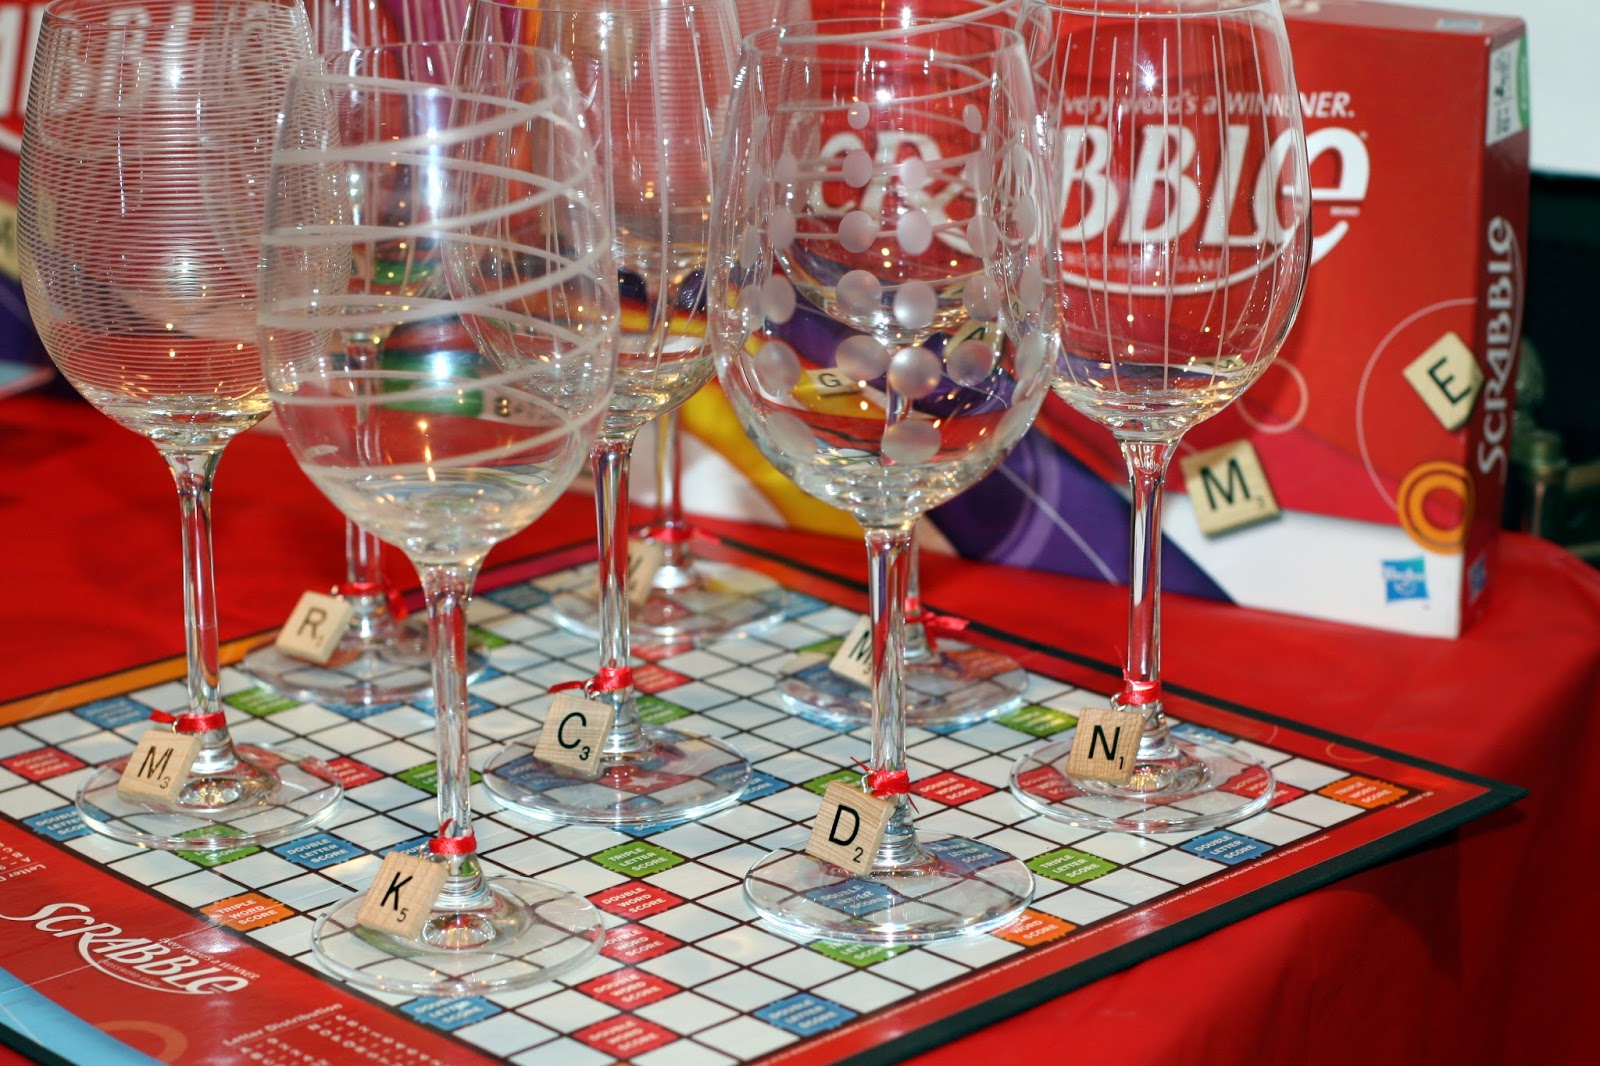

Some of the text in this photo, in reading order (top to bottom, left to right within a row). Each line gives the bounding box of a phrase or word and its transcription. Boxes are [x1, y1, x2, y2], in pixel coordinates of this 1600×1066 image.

[1044, 92, 1107, 121] very
[1429, 356, 1473, 405] E
[1200, 457, 1251, 512] M
[297, 606, 327, 639] R
[557, 711, 587, 749] C
[1087, 724, 1121, 761] N
[137, 745, 175, 781] M
[919, 776, 960, 793] DOUBLE
[934, 783, 966, 796] WORD
[945, 786, 980, 801] SCORE
[828, 803, 861, 847] D
[286, 837, 331, 856] DOUBLE
[1194, 834, 1233, 852] DOUBLE
[1209, 839, 1244, 856] LETTER
[299, 844, 339, 860] LETTER
[310, 848, 350, 865] SCORE
[608, 847, 646, 863] TRIPLE
[619, 851, 658, 867] LETTER
[1223, 844, 1257, 860] SCORE
[631, 856, 669, 872] SCORE
[1040, 853, 1075, 869] TRIPLE
[1051, 858, 1088, 874] LETTER
[1065, 863, 1101, 878] SCORE
[380, 871, 413, 911] K
[601, 886, 647, 905] DOUBLE
[216, 898, 257, 915] TRIPLE
[617, 893, 652, 908] WORD
[628, 898, 667, 913] SCORE
[229, 905, 266, 921] WORD
[237, 910, 279, 926] SCORE
[1022, 924, 1060, 940] SCORE
[613, 935, 650, 951] WORD
[624, 940, 665, 957] SCORE
[592, 973, 641, 994] DOUBLE
[609, 980, 647, 997] WORD
[620, 985, 662, 1003] SCORE
[798, 1010, 840, 1028] SCORE
[587, 1020, 637, 1042] DOUBLE
[605, 1027, 645, 1045] WORD
[616, 1032, 660, 1052] SCORE
